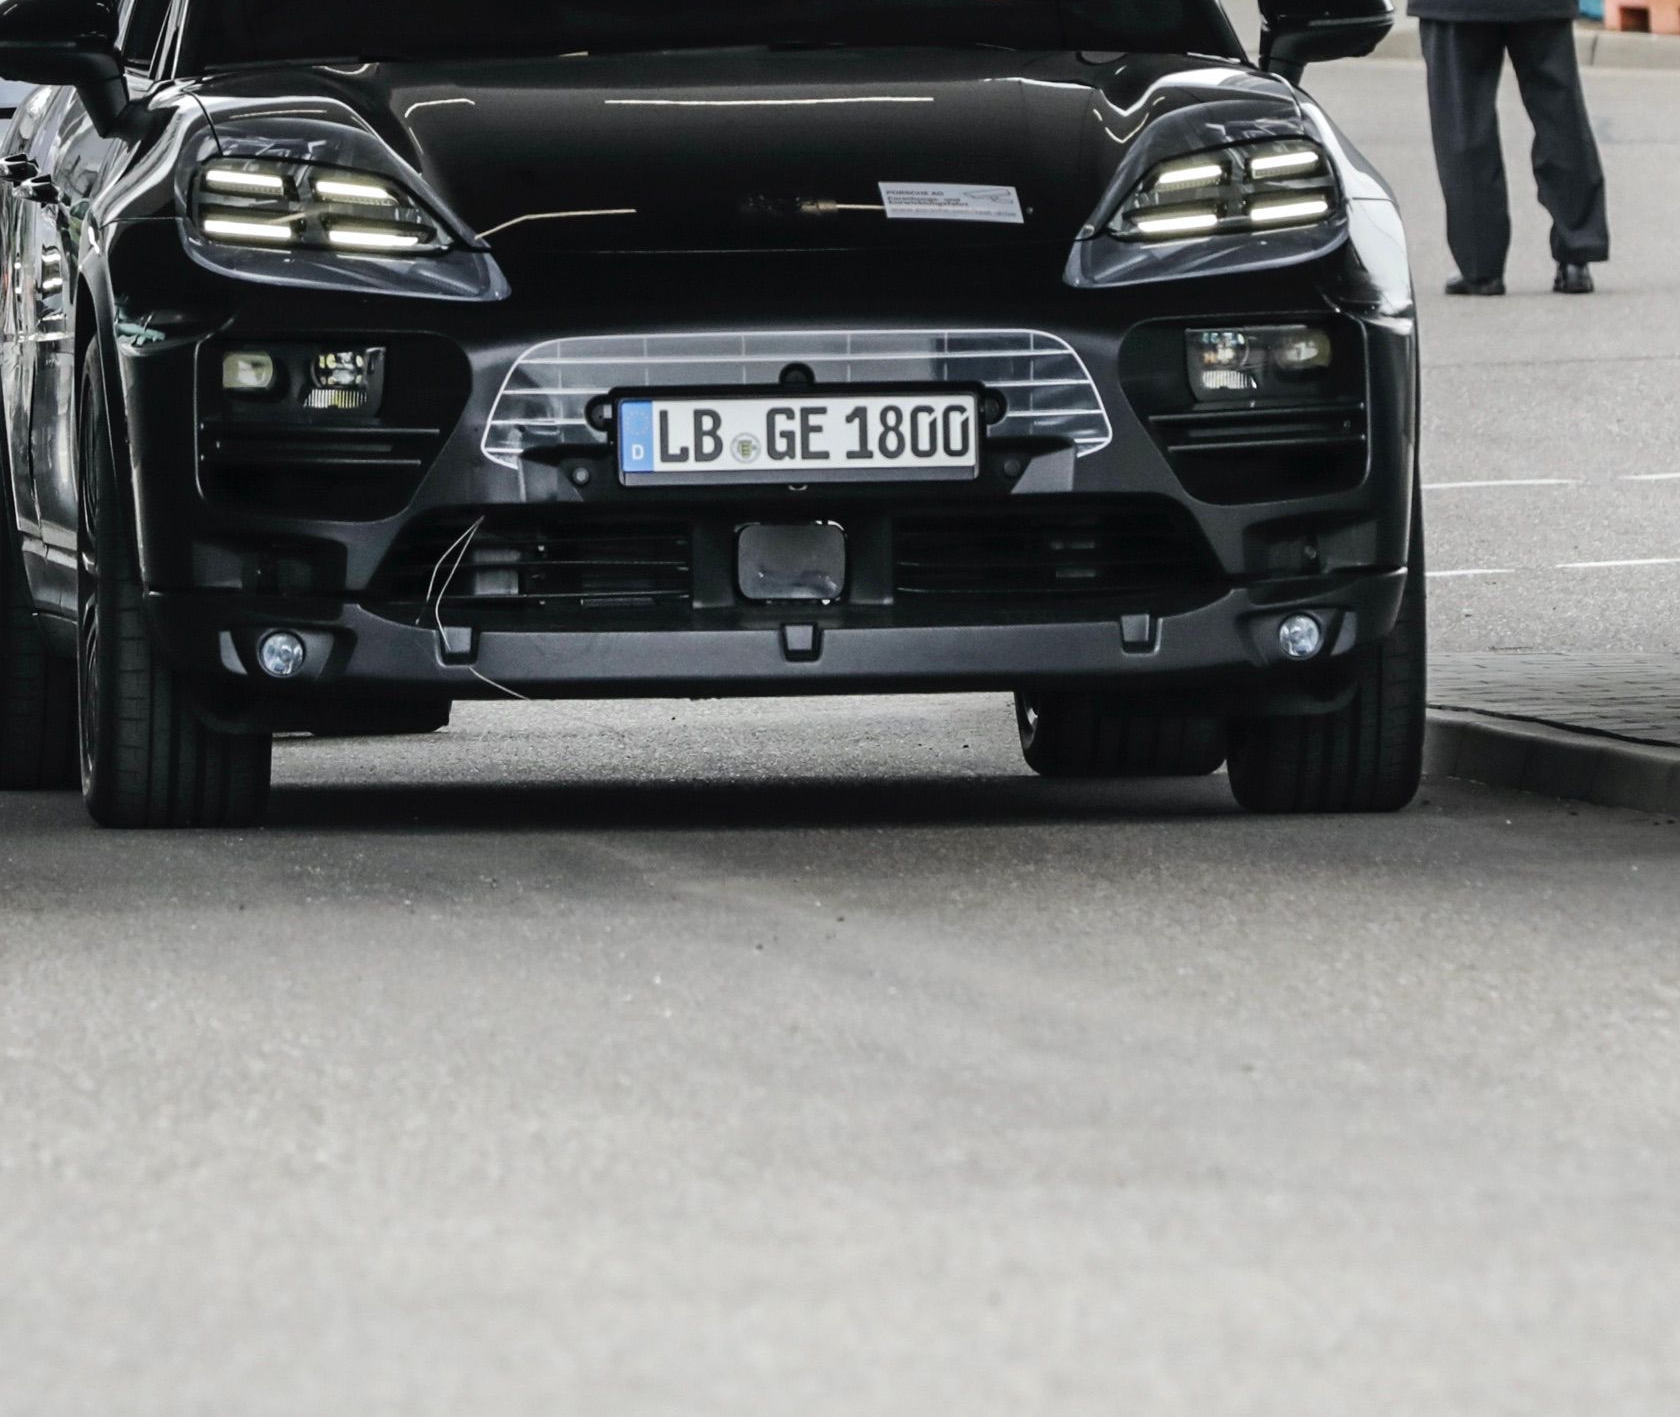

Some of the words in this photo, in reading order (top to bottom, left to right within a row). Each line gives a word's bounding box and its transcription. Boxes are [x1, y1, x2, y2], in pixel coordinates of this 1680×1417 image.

[632, 443, 644, 460] D
[659, 408, 724, 463] LB
[766, 406, 830, 461] GE
[845, 404, 970, 460] 1800
